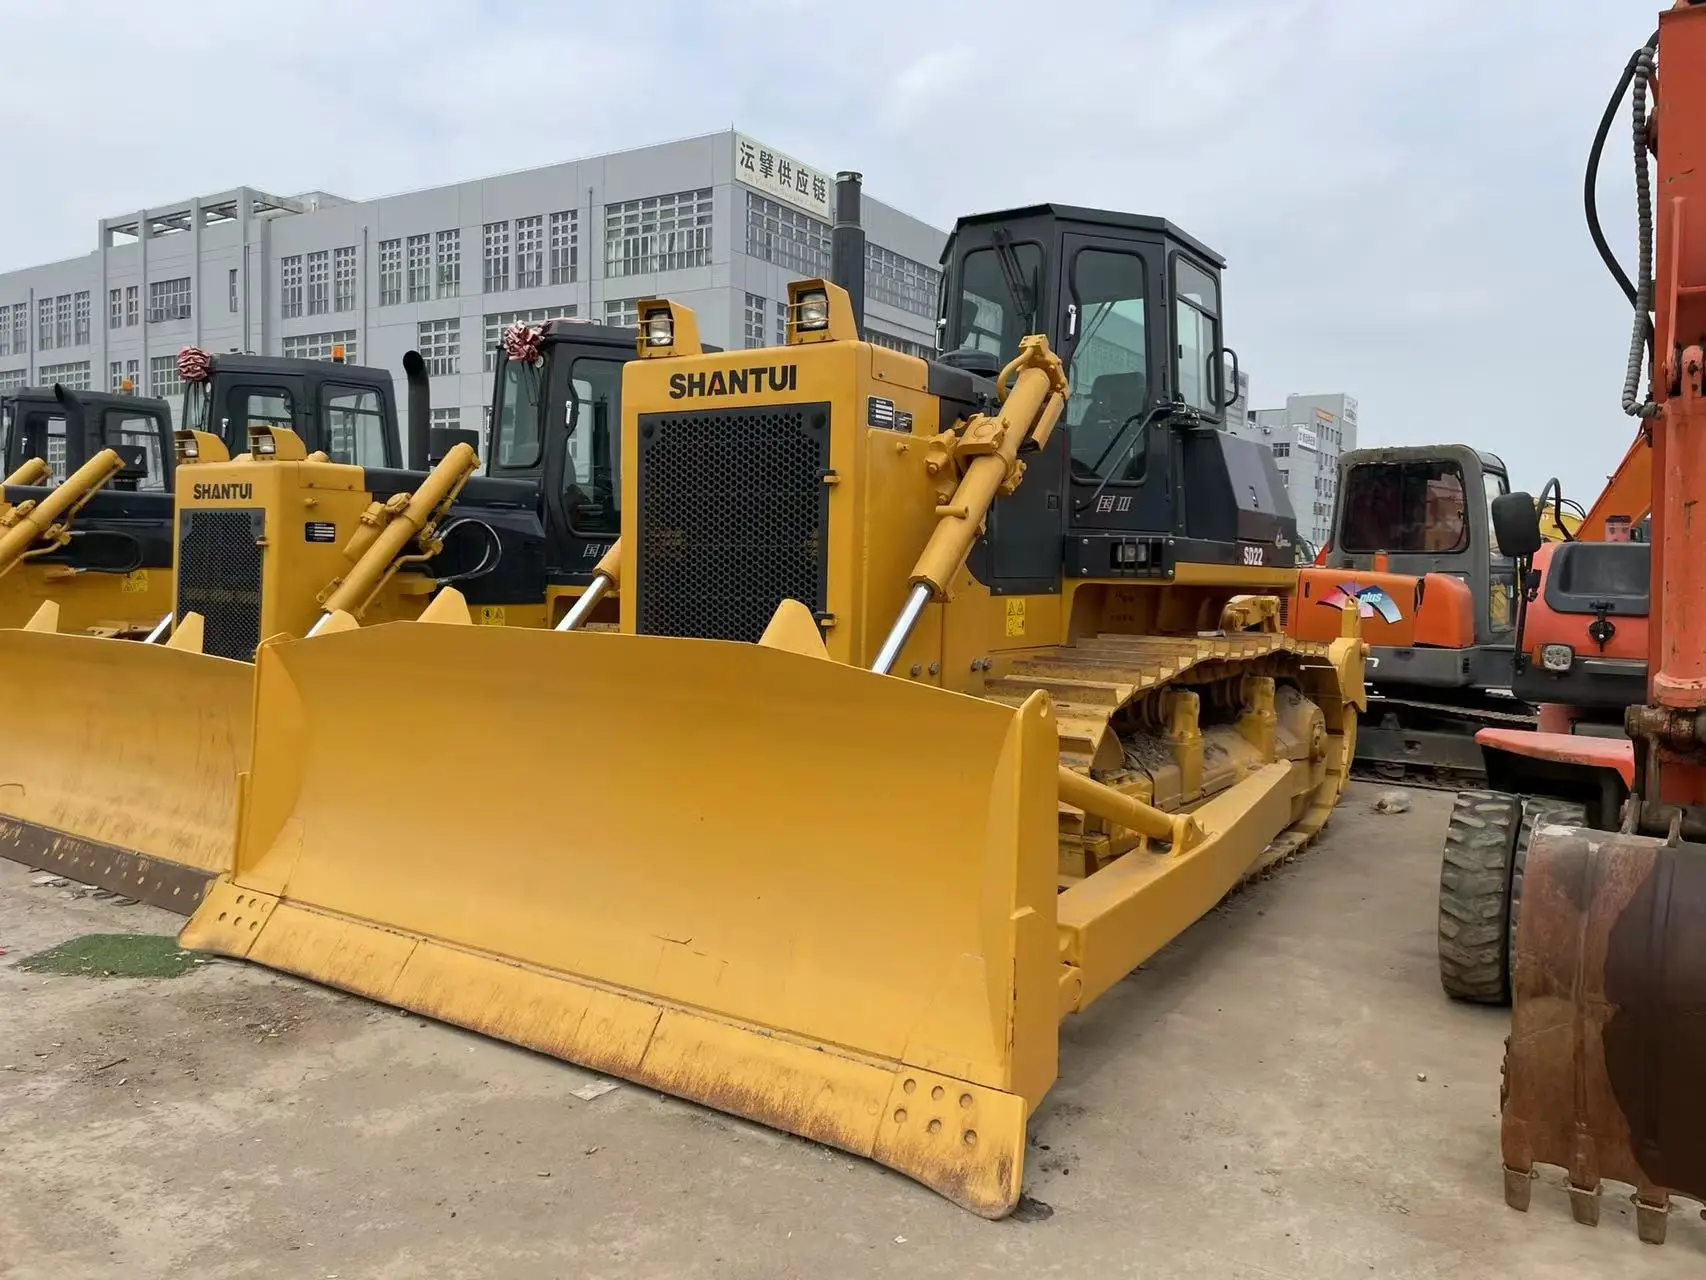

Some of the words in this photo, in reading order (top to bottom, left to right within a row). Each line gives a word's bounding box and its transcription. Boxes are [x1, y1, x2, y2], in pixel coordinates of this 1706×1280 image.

[669, 364, 797, 399] SHANTUI
[193, 483, 253, 500] SHANTUI
[1243, 546, 1263, 566] SD22
[1359, 591, 1383, 604] plus
